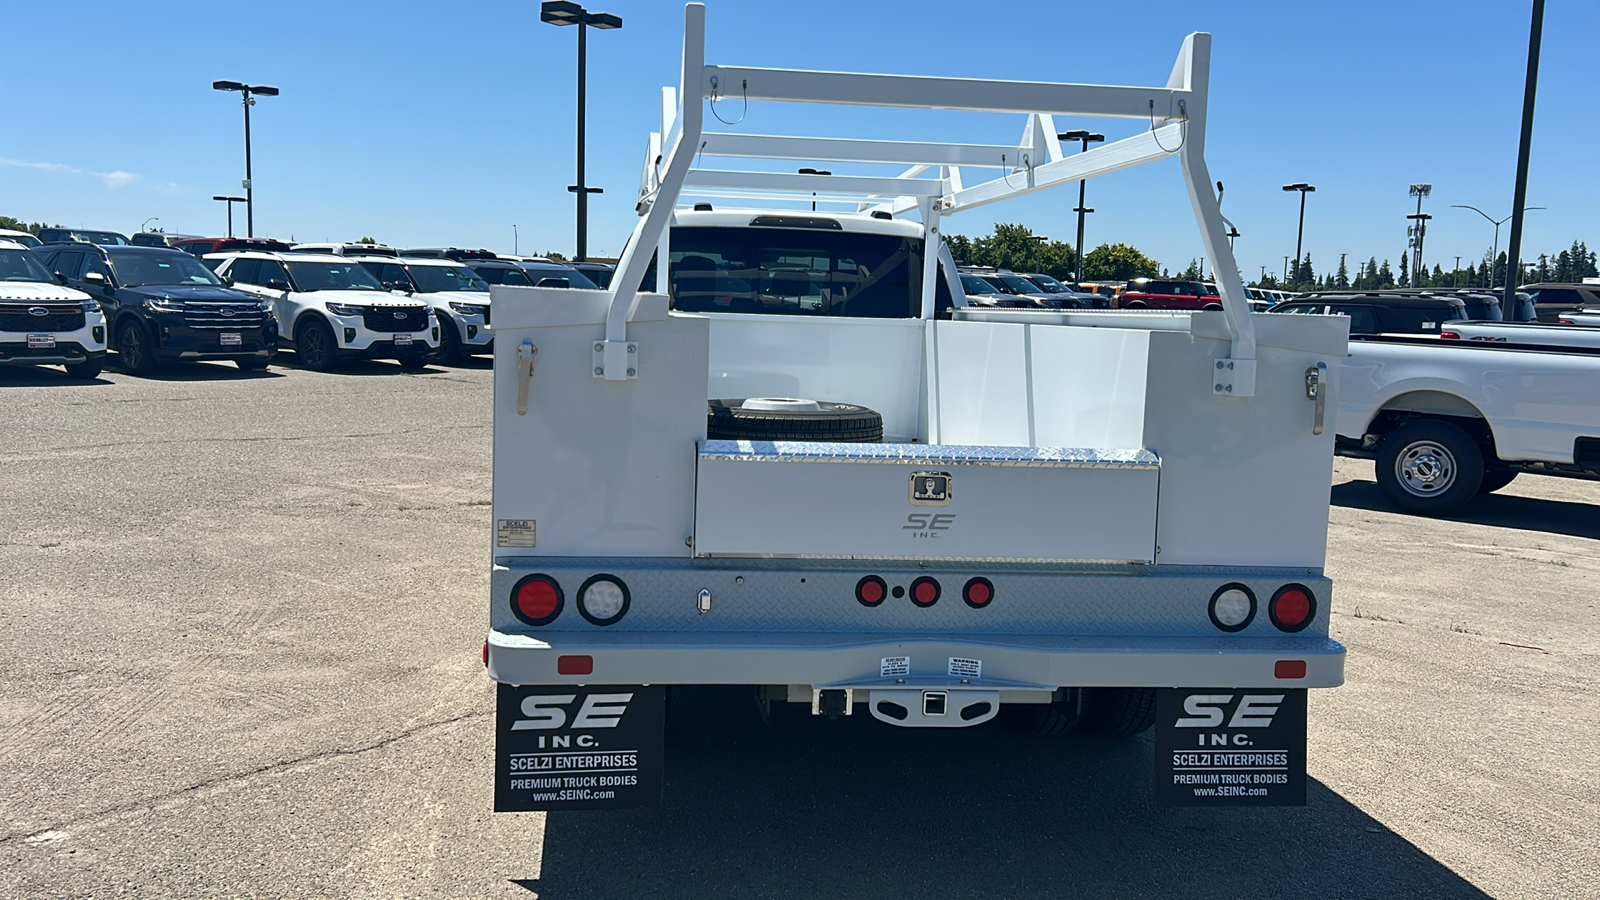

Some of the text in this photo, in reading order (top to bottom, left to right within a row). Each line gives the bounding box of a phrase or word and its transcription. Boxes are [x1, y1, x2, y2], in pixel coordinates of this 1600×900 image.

[902, 513, 957, 530] SE
[510, 692, 635, 731] SE
[1173, 694, 1286, 728] SE
[538, 734, 600, 749] INC.
[1198, 733, 1254, 746] INC.
[509, 754, 638, 771] SCELZI ENTERPRISES
[1172, 754, 1288, 766] SCELZI ENTERPRISES
[510, 775, 638, 790] PREMIUM TRUCK BODIES
[1173, 774, 1288, 784] PREMIUM TRUCK BODIES
[533, 789, 615, 802] www.SEINC.com
[1193, 786, 1268, 796] www.SEINC.com
